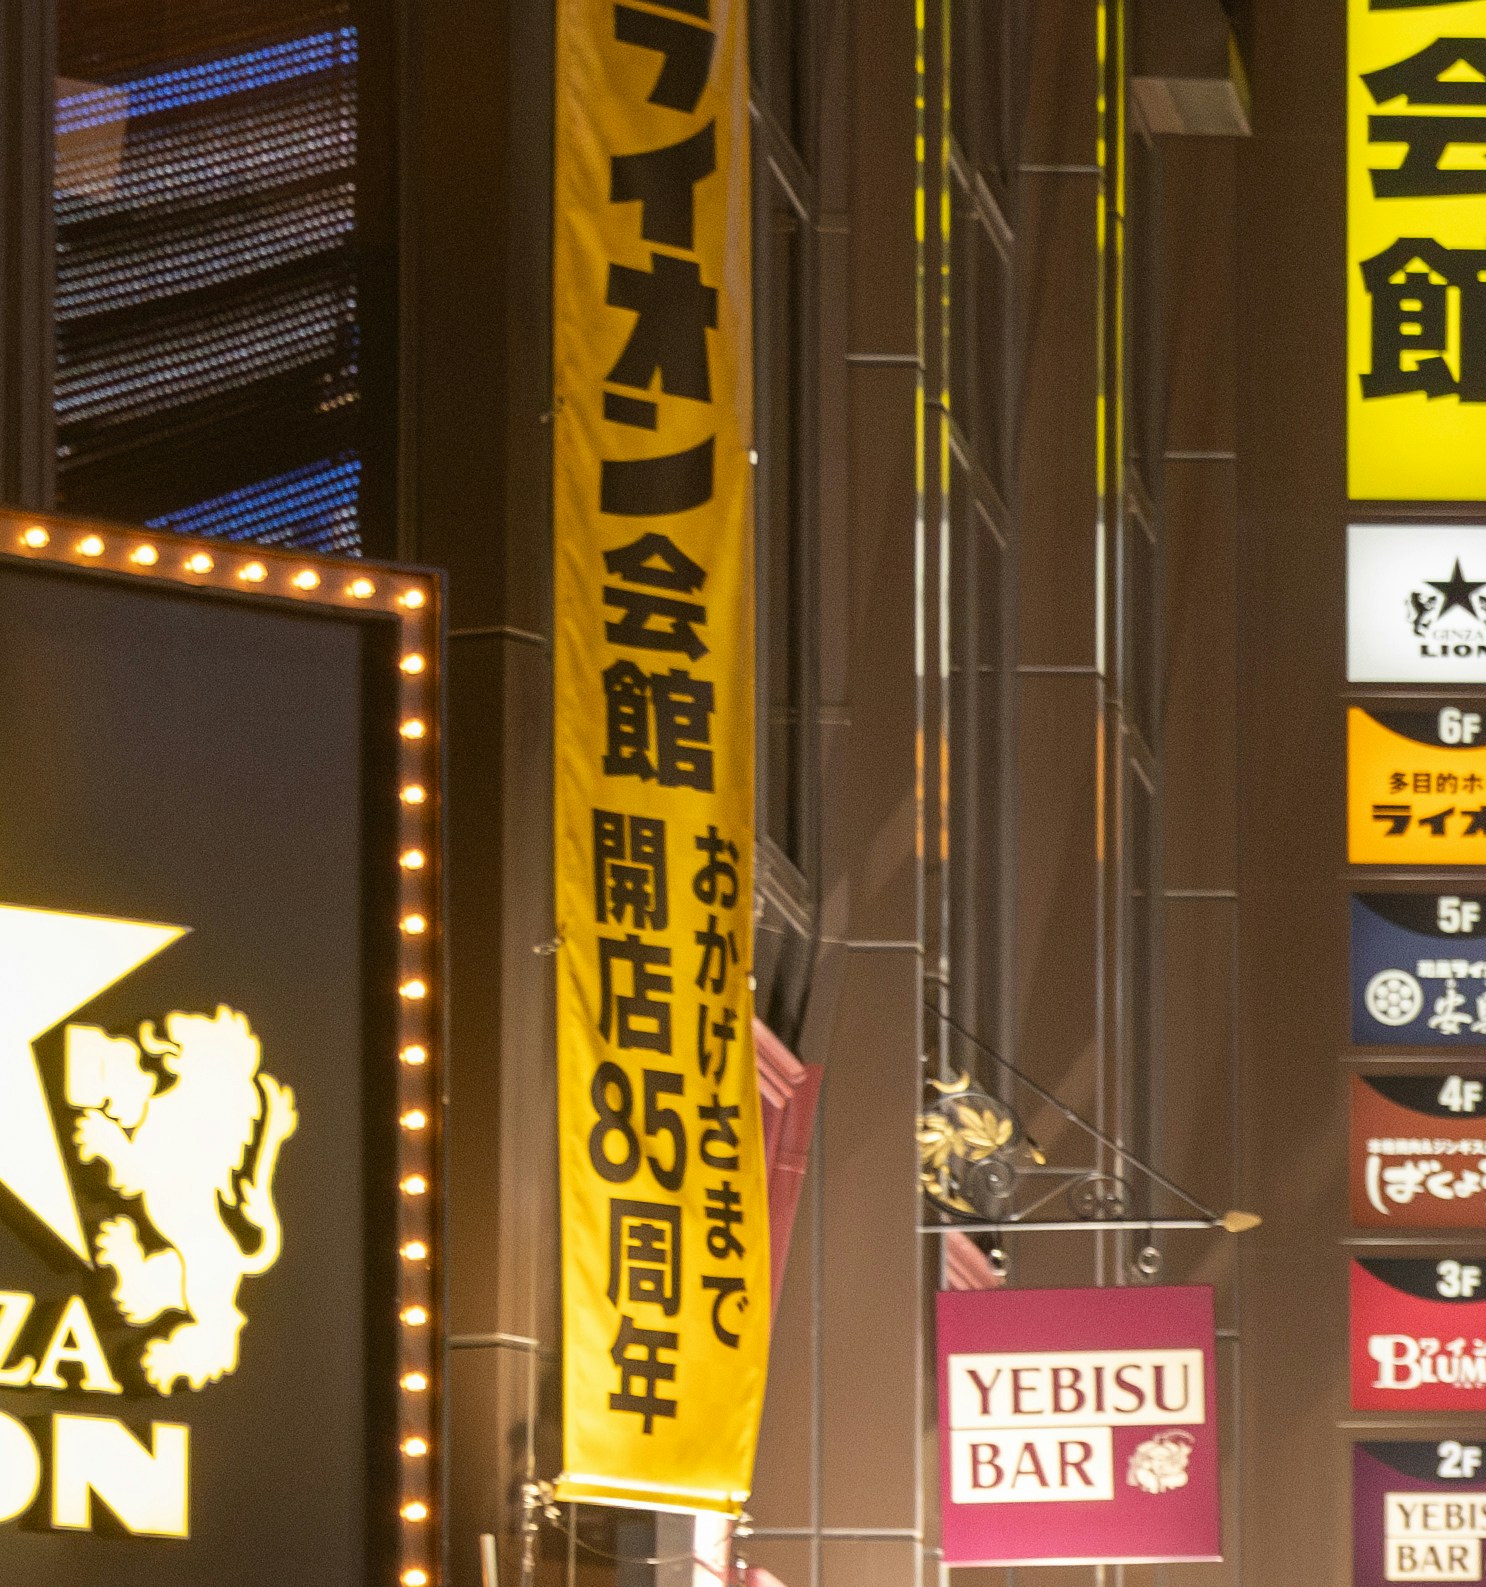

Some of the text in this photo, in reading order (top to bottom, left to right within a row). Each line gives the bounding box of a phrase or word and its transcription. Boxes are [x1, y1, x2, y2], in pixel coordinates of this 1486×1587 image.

[1432, 629, 1485, 642] GINZA
[1438, 706, 1482, 745] 6F
[1437, 895, 1481, 934] 5F
[693, 823, 748, 1348] おかげさまで
[1438, 1075, 1483, 1112] 4F
[589, 808, 688, 1435] 開店85周年
[1436, 1259, 1482, 1299] 3F
[965, 1363, 1193, 1417] YEBISU
[0, 1411, 191, 1540] N
[969, 1436, 1097, 1490] BAR
[1436, 1440, 1482, 1479] 2F
[1397, 1545, 1470, 1573] BAR
